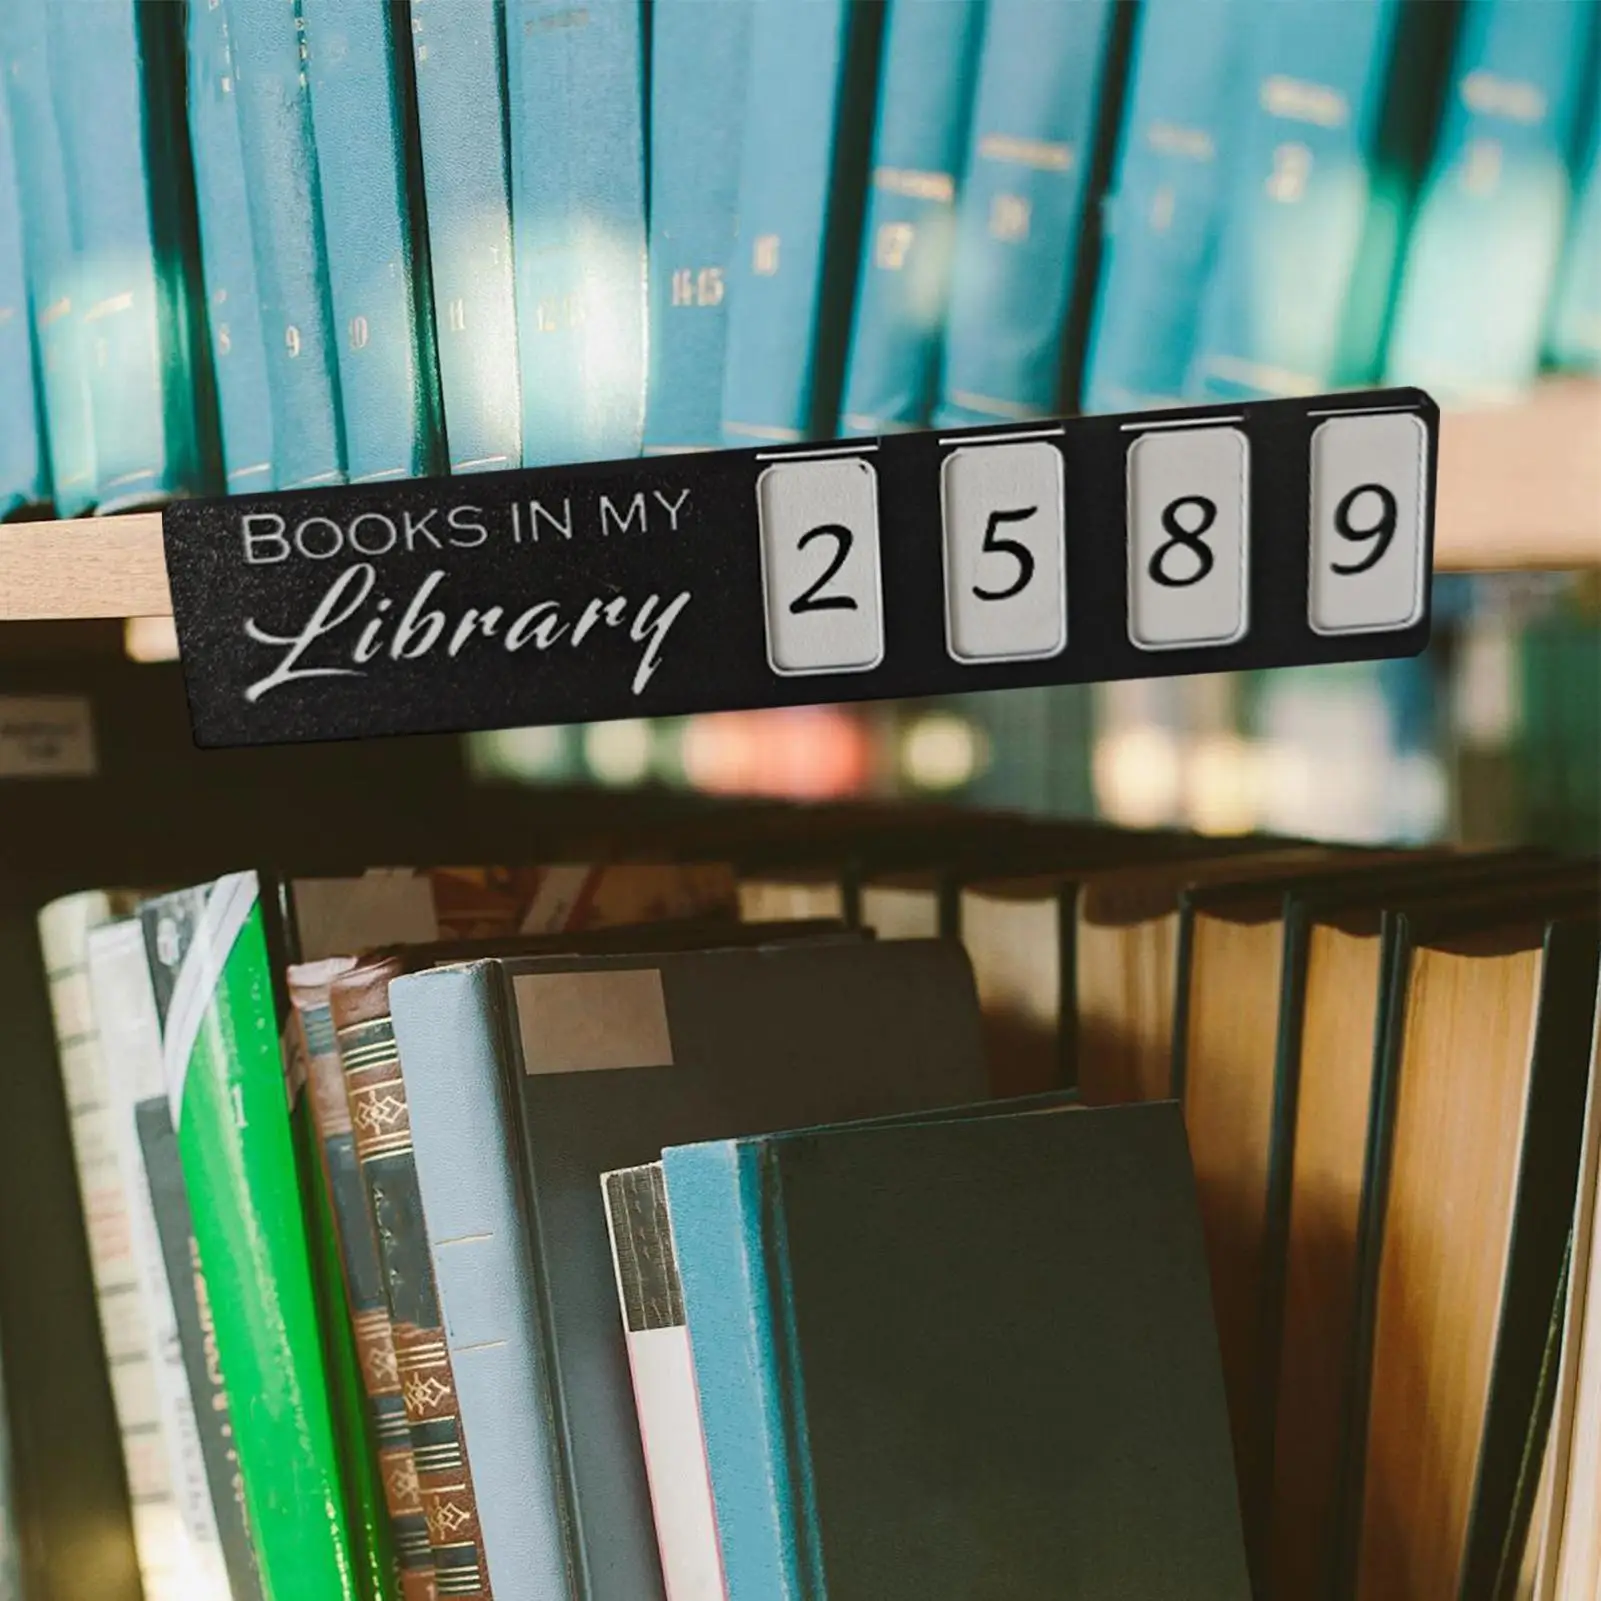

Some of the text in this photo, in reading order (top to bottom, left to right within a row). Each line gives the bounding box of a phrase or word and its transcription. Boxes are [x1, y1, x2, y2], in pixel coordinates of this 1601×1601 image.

[285, 324, 300, 359] 9
[241, 488, 692, 565] BOOKS IN MY
[788, 482, 1398, 615] 2 5 8 9
[244, 562, 693, 702] Library
